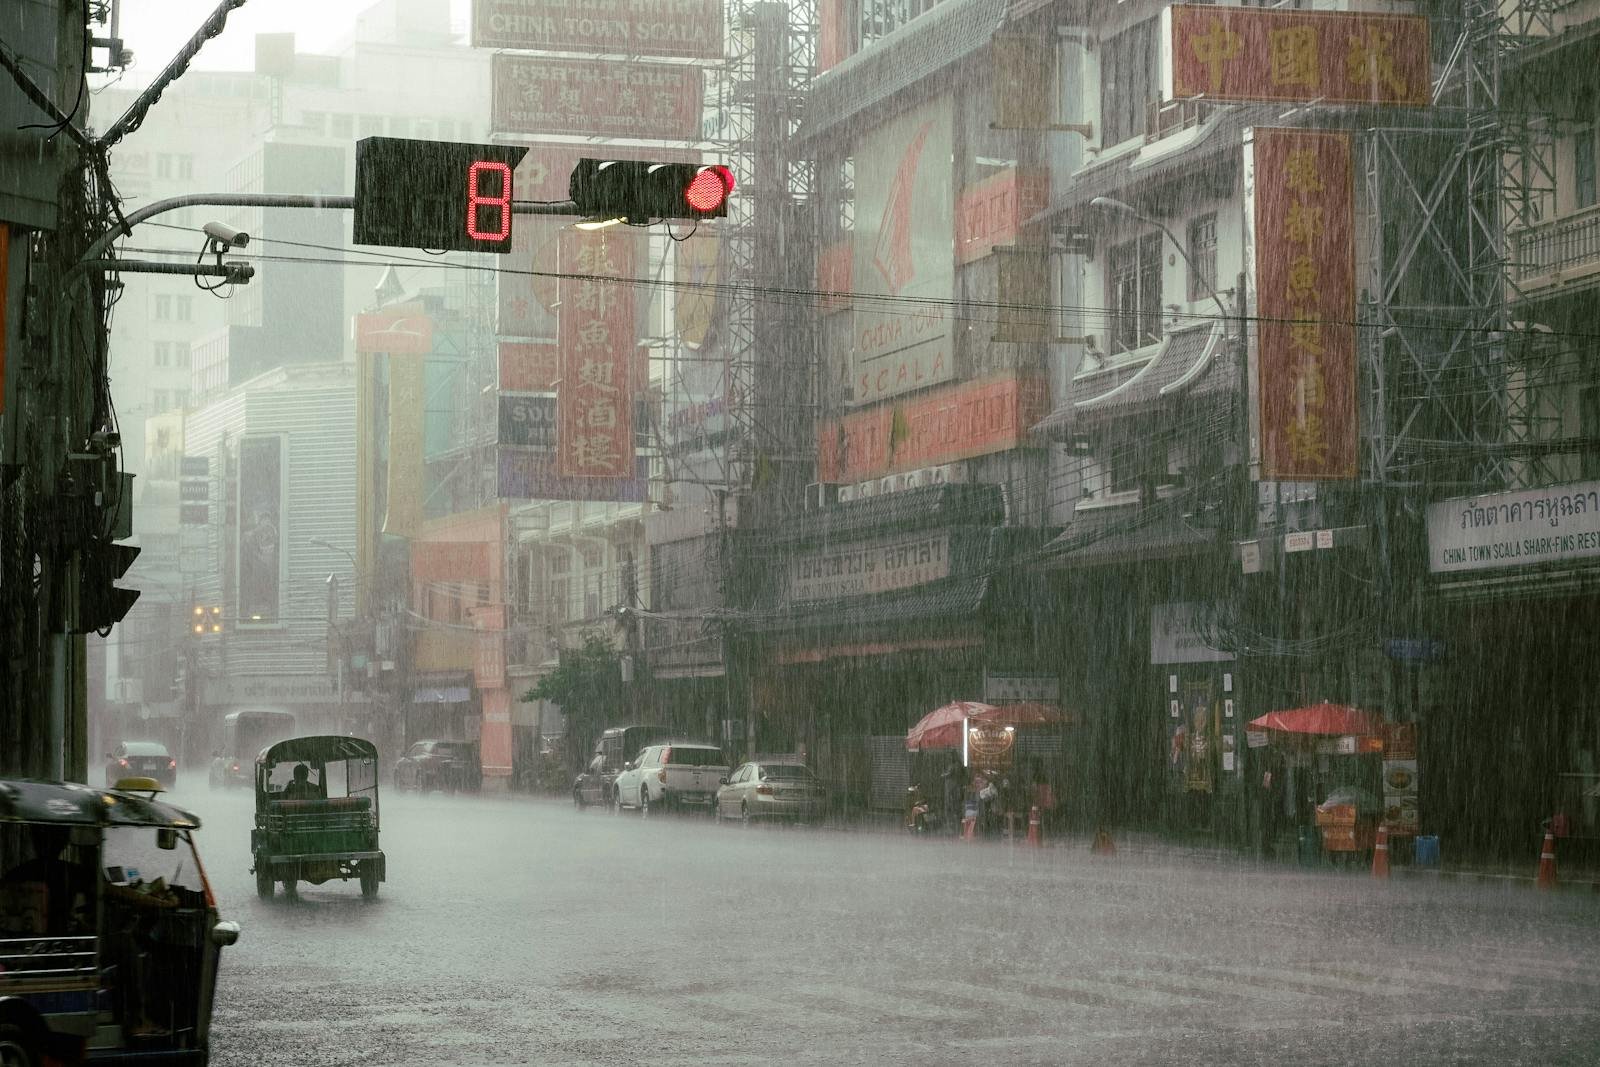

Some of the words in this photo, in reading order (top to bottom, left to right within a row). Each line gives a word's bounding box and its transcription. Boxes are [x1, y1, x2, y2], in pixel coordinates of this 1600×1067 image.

[490, 14, 556, 35] CHINA
[564, 18, 630, 40] TOWN
[637, 22, 705, 42] SCALA
[467, 161, 511, 240] 8
[861, 318, 902, 352] CHINA
[861, 352, 944, 397] SCALA
[1443, 548, 1467, 564] CHINA
[1469, 544, 1491, 561] TOWN
[1493, 541, 1521, 560] SCALA
[1524, 535, 1574, 556] SHARK-FINS
